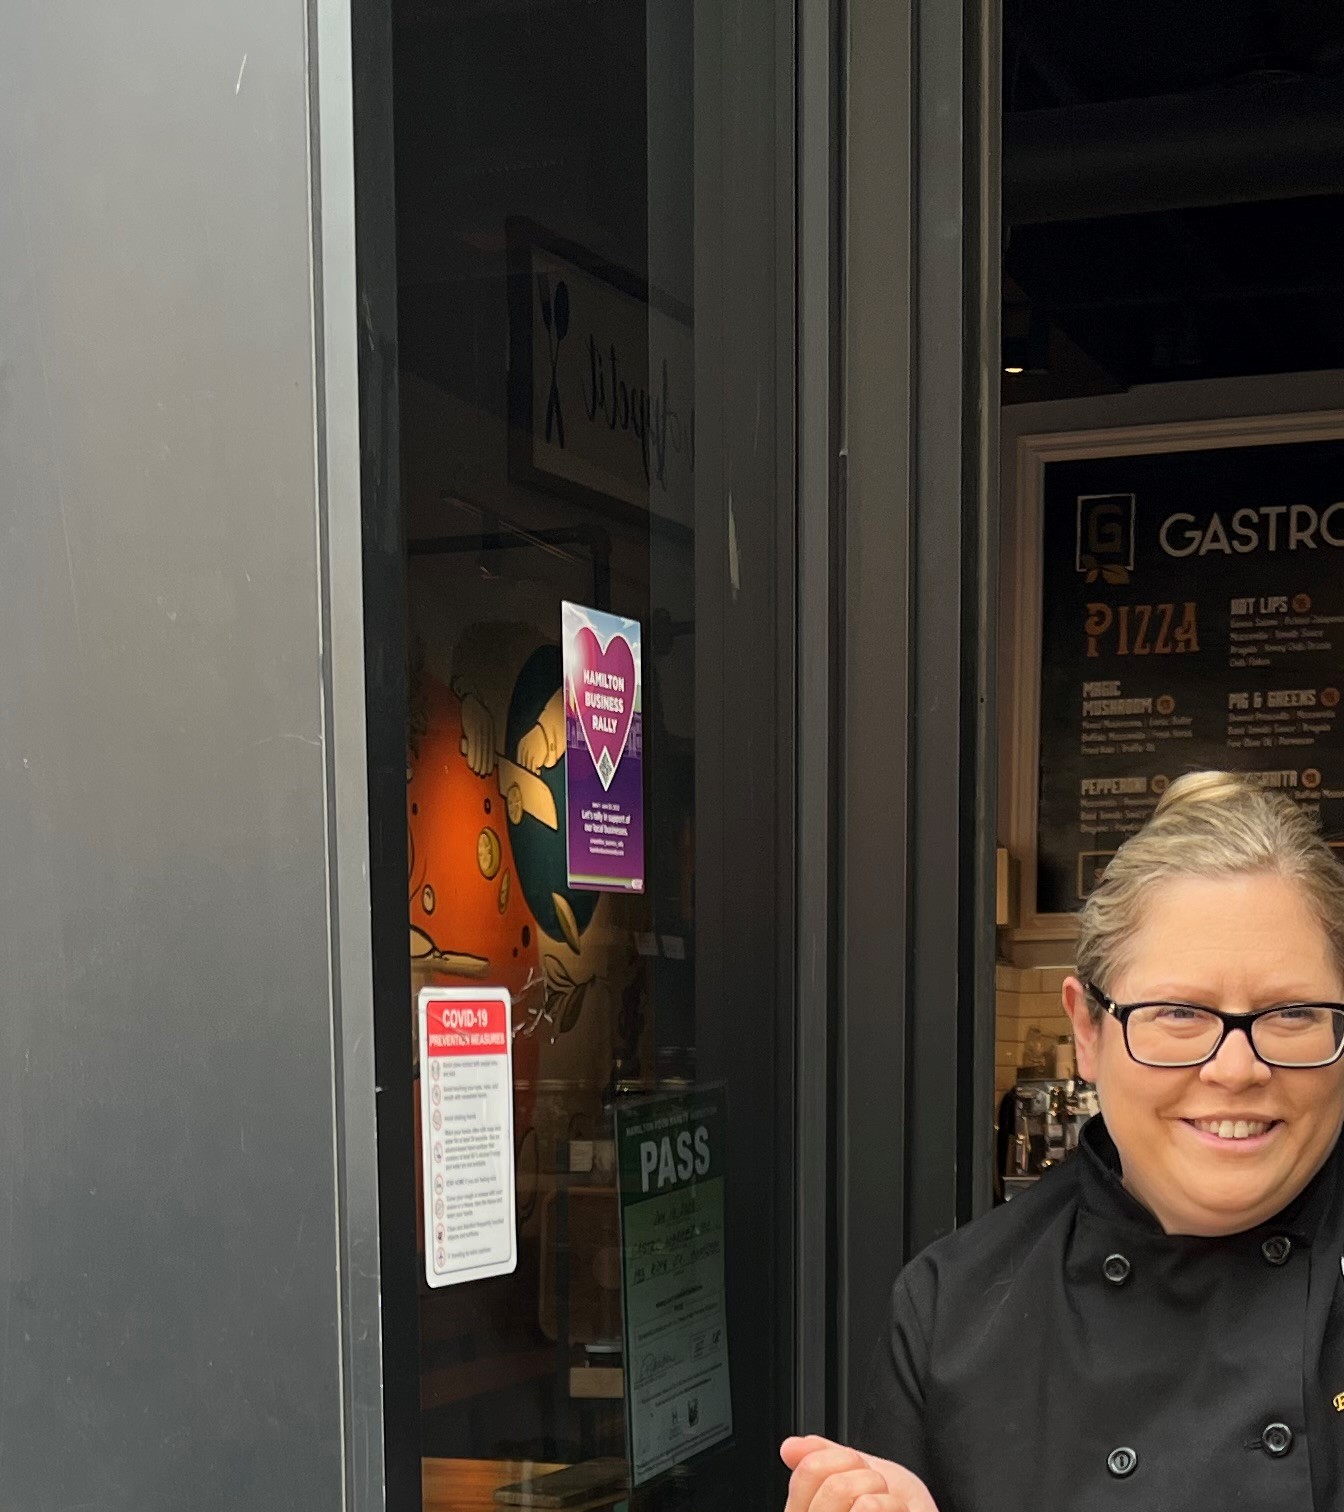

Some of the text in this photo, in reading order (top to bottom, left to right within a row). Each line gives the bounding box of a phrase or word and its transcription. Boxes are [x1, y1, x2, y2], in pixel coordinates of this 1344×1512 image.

[1259, 596, 1288, 614] LIPS
[1084, 600, 1201, 658] PIZZA
[583, 669, 625, 692] HAMILTON
[584, 691, 624, 713] BUSINESS
[592, 714, 617, 734] RALLY
[442, 1008, 488, 1029] COVID-19
[640, 1125, 710, 1193] PASS
